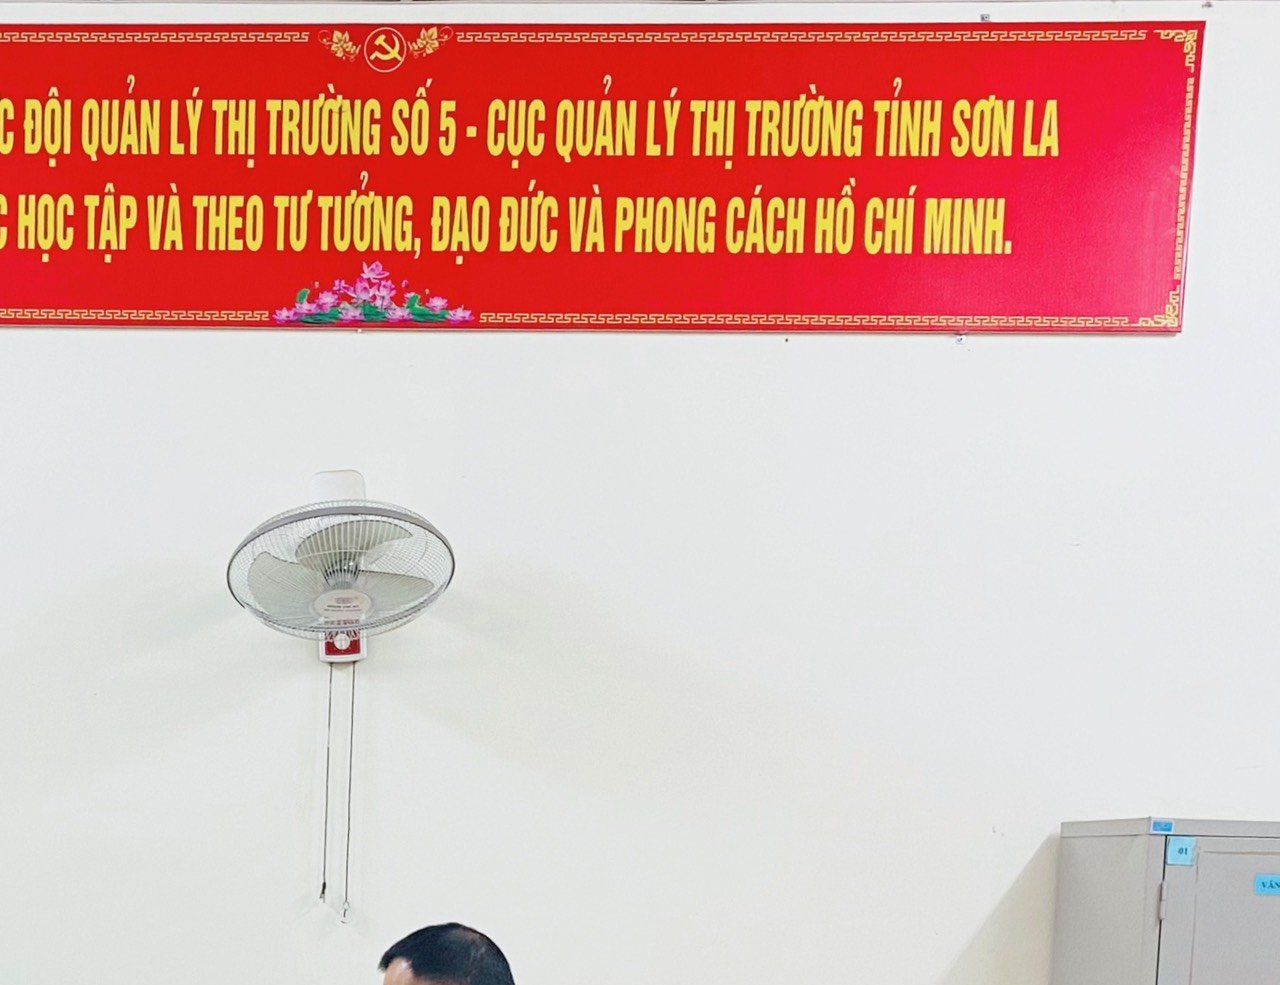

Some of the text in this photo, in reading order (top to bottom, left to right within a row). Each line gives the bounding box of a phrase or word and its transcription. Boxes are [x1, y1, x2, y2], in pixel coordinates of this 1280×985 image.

[23, 86, 72, 168] ĐỘI
[81, 74, 161, 162] QUẢN
[170, 86, 204, 155] LÝ
[211, 99, 257, 169] THỊ
[265, 83, 382, 156] TRƯỜNG
[390, 78, 433, 156] SỐ
[438, 100, 457, 156] 5
[486, 99, 546, 169] CỤC
[555, 74, 638, 163] QUẢN
[645, 86, 682, 156] LÝ
[689, 100, 736, 170] THỊ
[745, 84, 864, 157] TRƯỜNG
[873, 77, 943, 157] TỈNH
[950, 95, 1015, 158] SƠN
[1022, 99, 1059, 158] LA
[17, 193, 75, 263] HỌC
[83, 182, 138, 263] TẬP
[147, 182, 184, 251] VÀ
[192, 194, 264, 252] THEO
[273, 189, 313, 252] TƯ
[317, 170, 421, 260] TƯỞNG,
[430, 195, 490, 265] ĐẠO
[499, 179, 559, 253] ĐỨC
[568, 184, 605, 253] VÀ
[614, 195, 717, 254] PHONG
[725, 184, 807, 254] CÁCH
[814, 177, 856, 255] HỒ
[863, 184, 917, 255] CHÍ
[923, 197, 1012, 255] MINH.
[1178, 847, 1188, 855] 01
